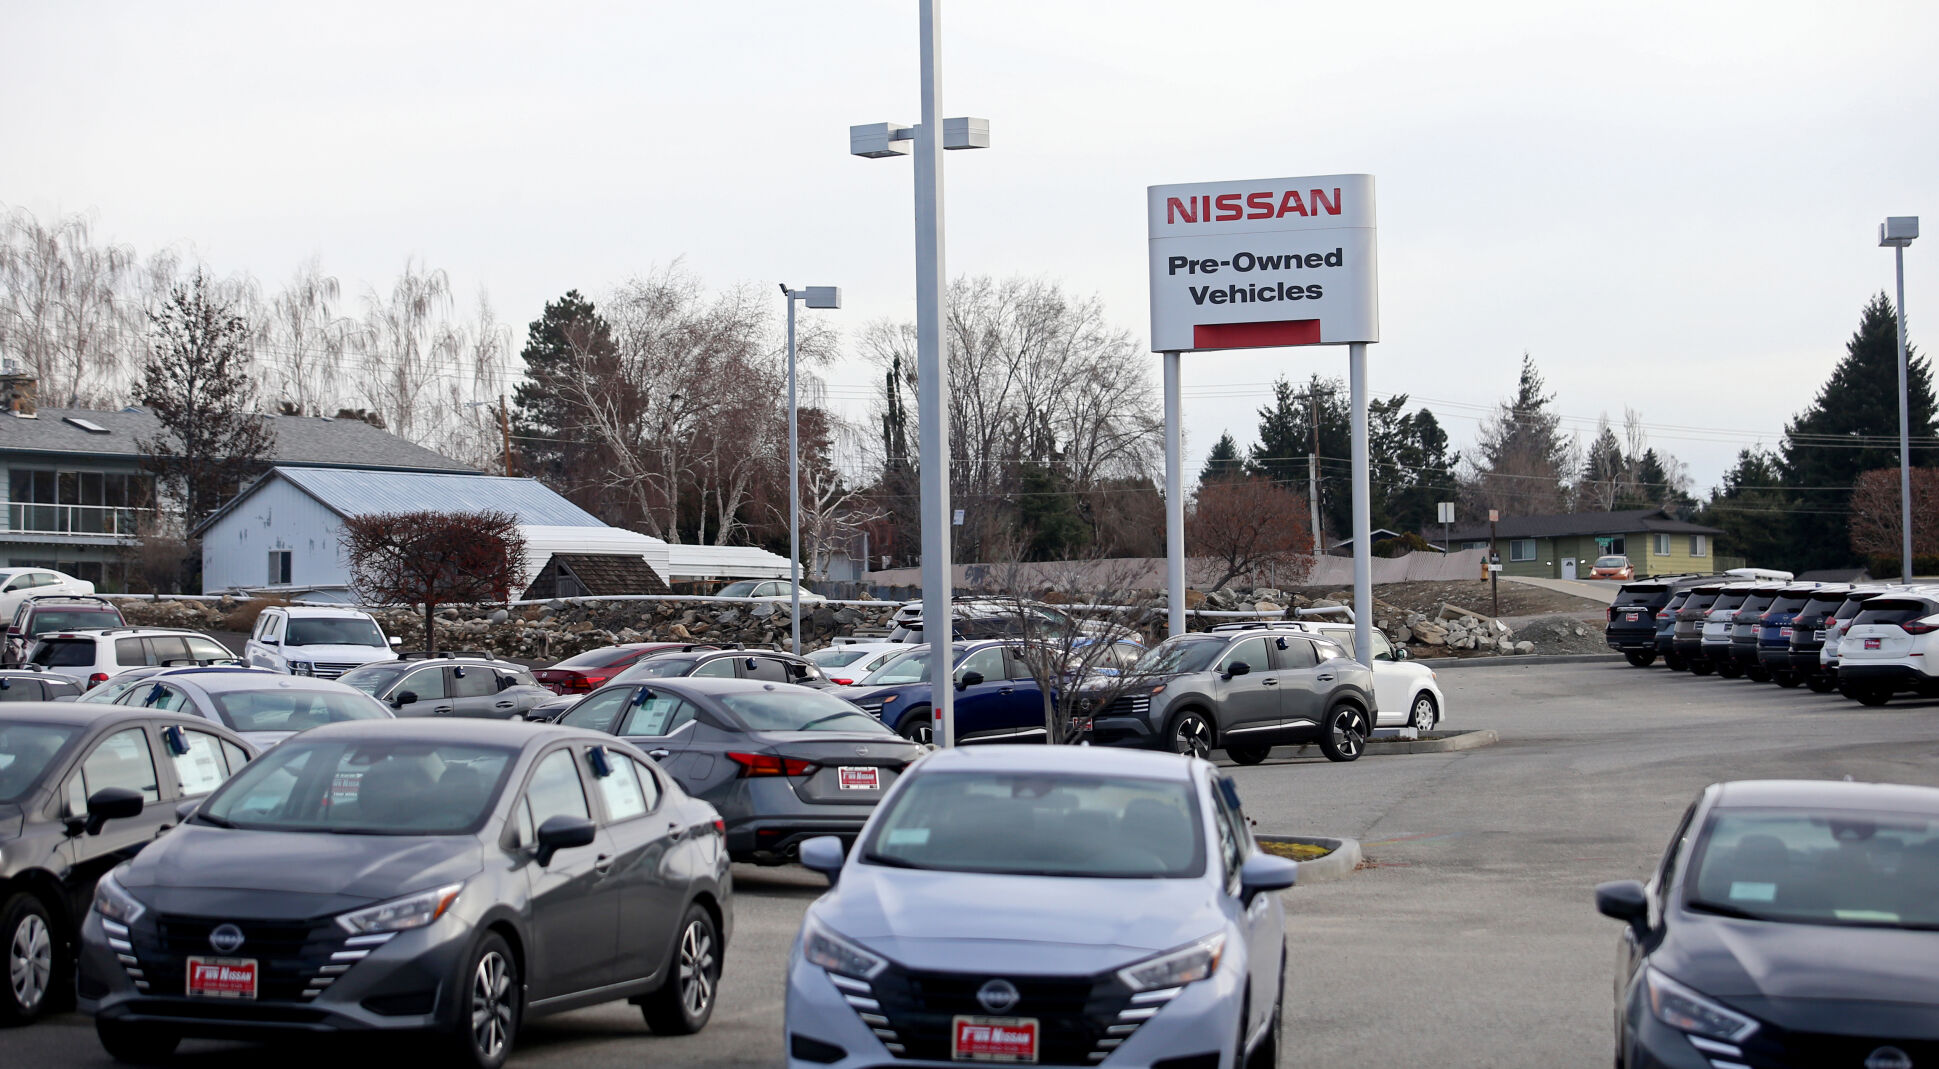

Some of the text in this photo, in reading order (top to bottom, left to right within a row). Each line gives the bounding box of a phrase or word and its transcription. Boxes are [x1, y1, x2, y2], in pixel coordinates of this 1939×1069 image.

[1167, 188, 1341, 224] NISSAN
[1168, 248, 1343, 275] Pre-Owned
[1189, 282, 1323, 305] Vehicles
[220, 967, 252, 981] NISSAN
